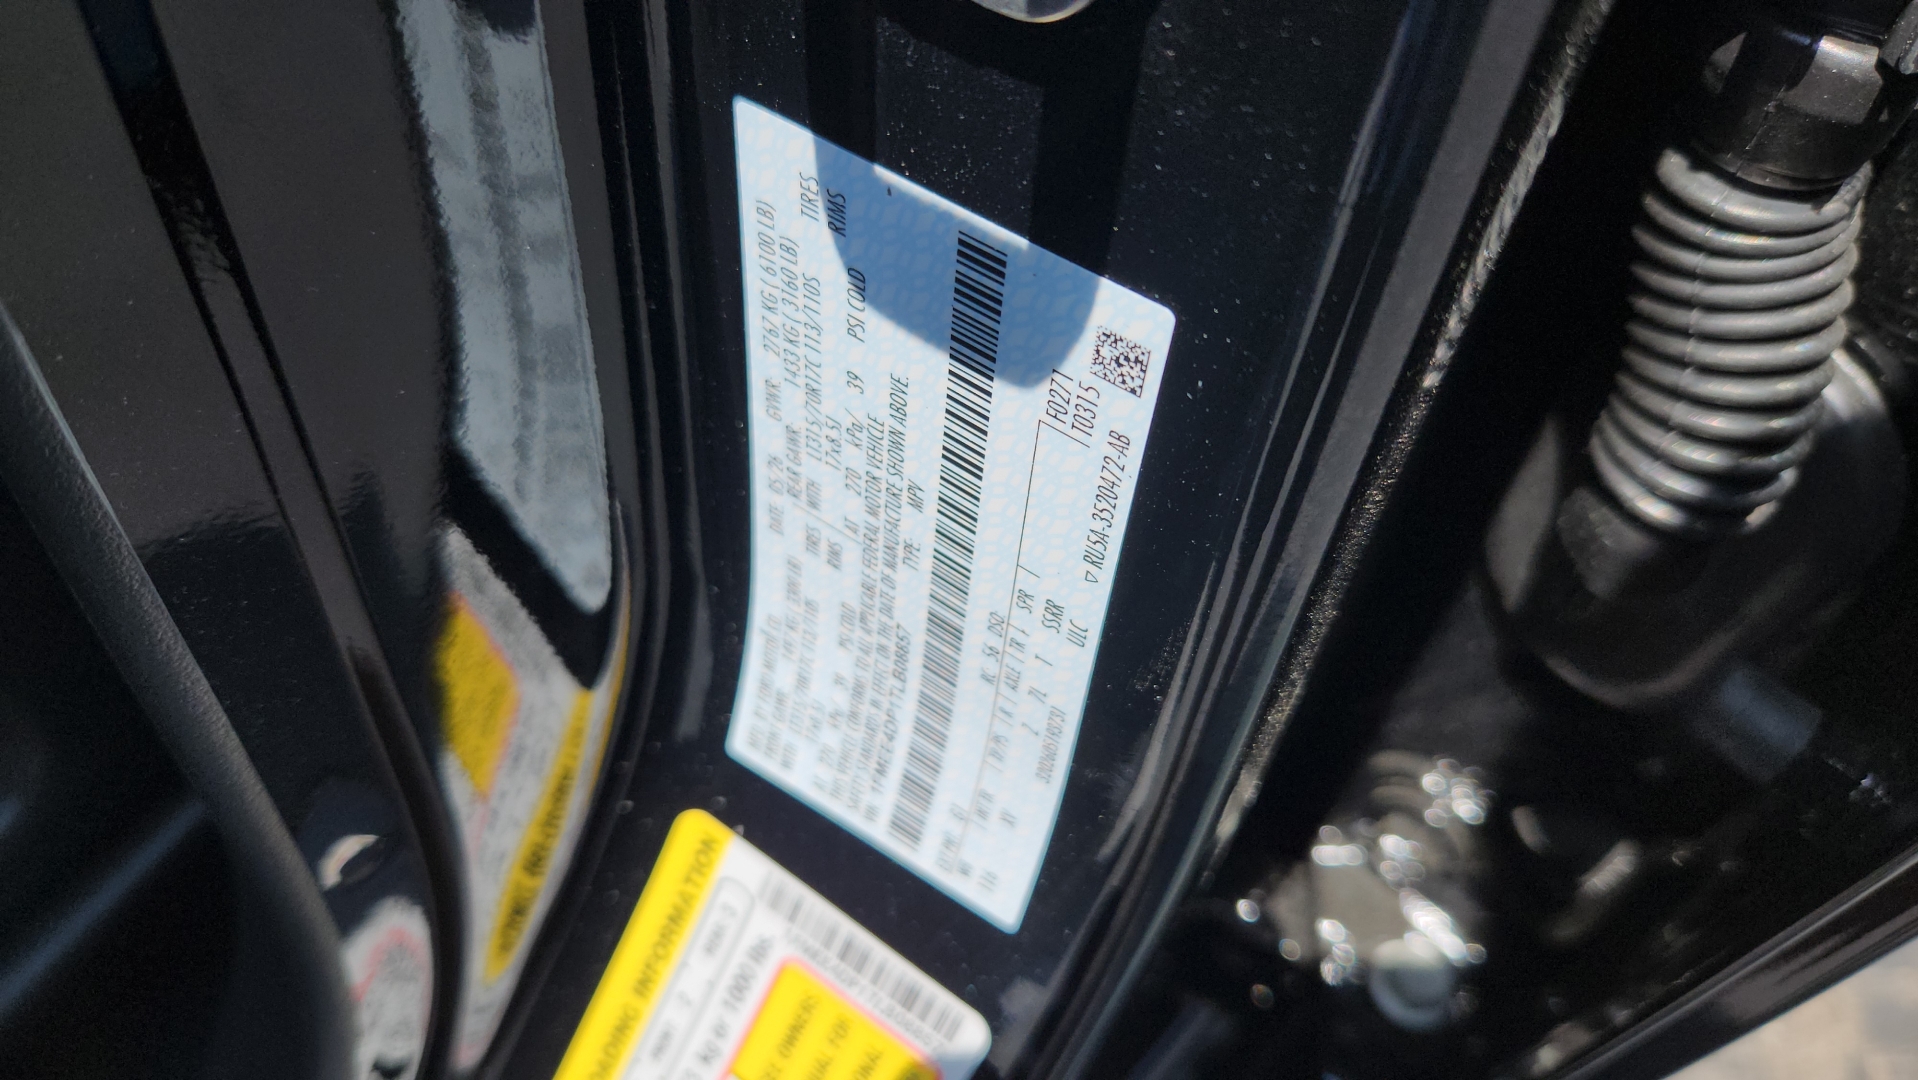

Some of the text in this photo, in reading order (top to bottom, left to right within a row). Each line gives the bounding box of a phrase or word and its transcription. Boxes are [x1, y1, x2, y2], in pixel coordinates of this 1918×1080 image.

[755, 195, 776, 231] LB)
[757, 229, 777, 278] 6100
[778, 232, 799, 266] LB)
[761, 287, 778, 317] KG
[780, 263, 799, 313] 3160
[762, 313, 780, 358] 2767
[782, 320, 799, 348] KG
[799, 169, 822, 513] WITH LT315/70R17C 113/110S TIRES
[825, 186, 846, 473] 17x8.5J RIMS
[783, 346, 801, 389] 1433
[764, 373, 781, 423] GVWR:
[844, 264, 866, 537] AT 270 kPa/ 39 PSI COLD
[889, 367, 909, 428] ABOVE.
[1045, 367, 1073, 425] F0271
[1071, 379, 1101, 439] T0315
[785, 418, 801, 468] GAWR:
[866, 411, 885, 474] VEHICLE
[886, 423, 906, 482] SHOWN
[768, 451, 783, 497] 05/26
[786, 464, 802, 501] REAR
[864, 468, 883, 521] MOTOR
[1082, 426, 1131, 571] RU5A-3520472-AB
[805, 521, 821, 558] TIRES
[863, 516, 879, 573] FEDERAL
[882, 477, 903, 573] MANUFACTURE
[903, 476, 925, 572] TYPE: MPV
[826, 536, 842, 571] RIMS
[880, 568, 896, 591] OF
[1015, 586, 1035, 614] SPR
[839, 598, 856, 634] COLD
[858, 569, 877, 637] APPLICABLE
[877, 585, 895, 621] DATE
[987, 606, 1005, 638] DSO:
[1041, 596, 1065, 634] SSRR
[856, 633, 872, 658] ALL
[875, 637, 891, 661] ON
[877, 615, 893, 641] THE
[1009, 635, 1026, 654] TR
[1065, 617, 1088, 649] ULC
[760, 630, 778, 673] MOTOR
[854, 652, 870, 674] TO
[983, 640, 1000, 663] 56
[1034, 652, 1053, 668] T
[756, 670, 774, 704] FORD
[871, 655, 889, 697] EFFECT
[1002, 661, 1021, 693] AXLE
[1027, 682, 1047, 704] 7L
[845, 668, 868, 733] CONFORMS
[867, 692, 883, 711] IN
[997, 703, 1013, 719] R
[854, 706, 880, 774] STANDARDS
[628, 828, 723, 1001] INFORMATION
[718, 961, 758, 1015] 1000
